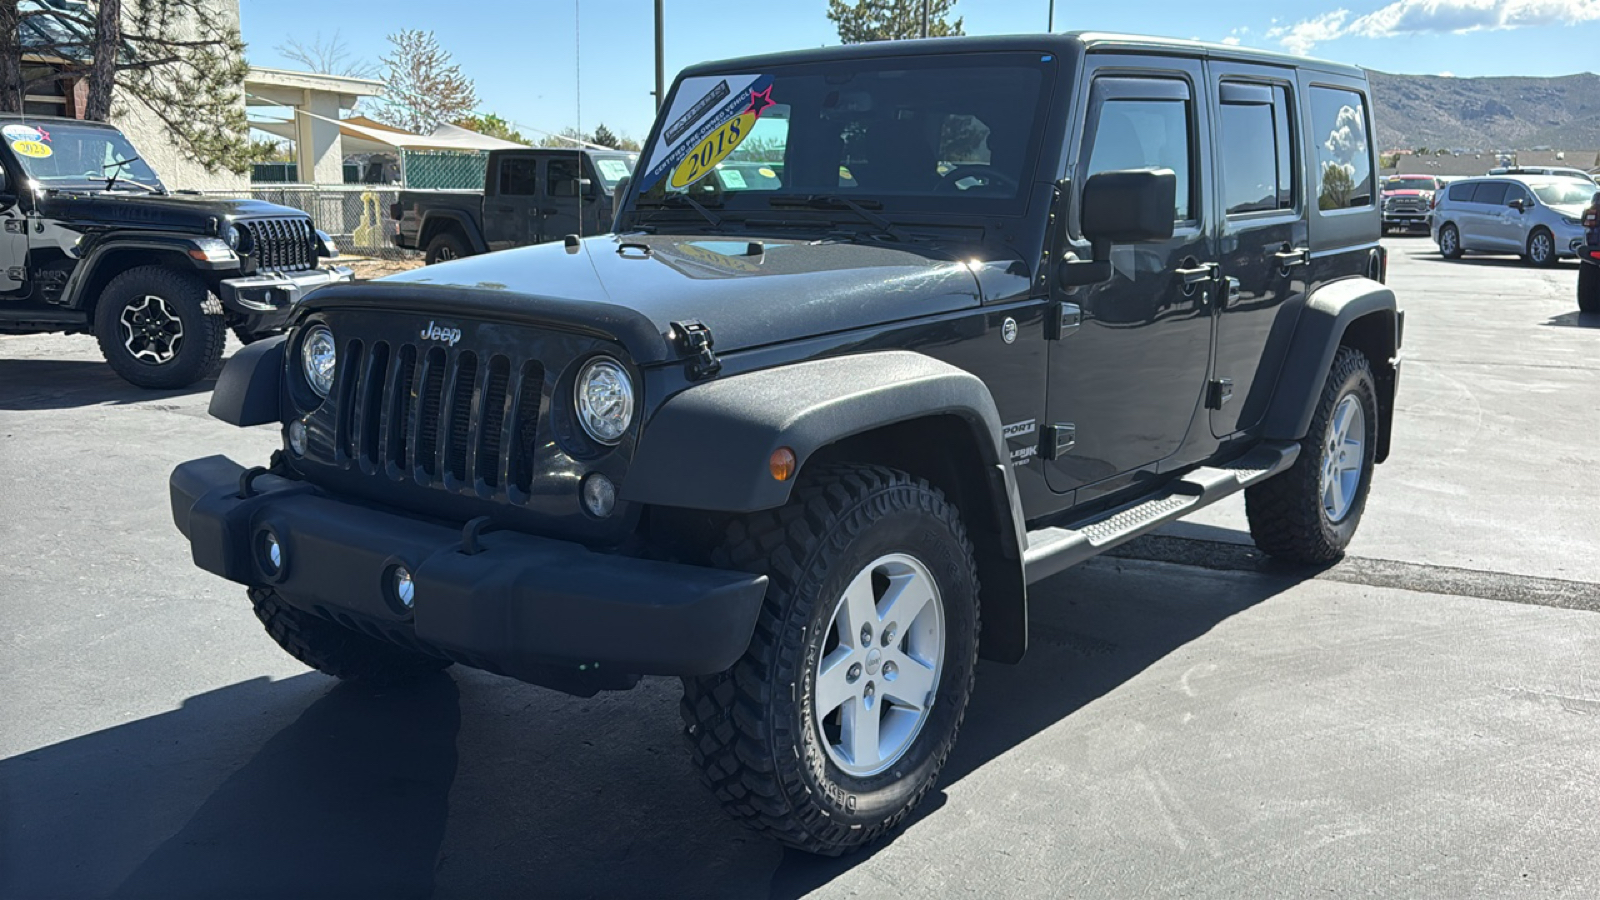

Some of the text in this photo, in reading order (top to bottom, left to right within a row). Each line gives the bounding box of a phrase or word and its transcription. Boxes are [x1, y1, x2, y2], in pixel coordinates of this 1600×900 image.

[654, 144, 685, 175] CERTIFIED
[725, 86, 754, 112] VEHICLE
[687, 117, 741, 181] 2018
[420, 320, 462, 347] Jeep
[1003, 423, 1032, 434] PORT
